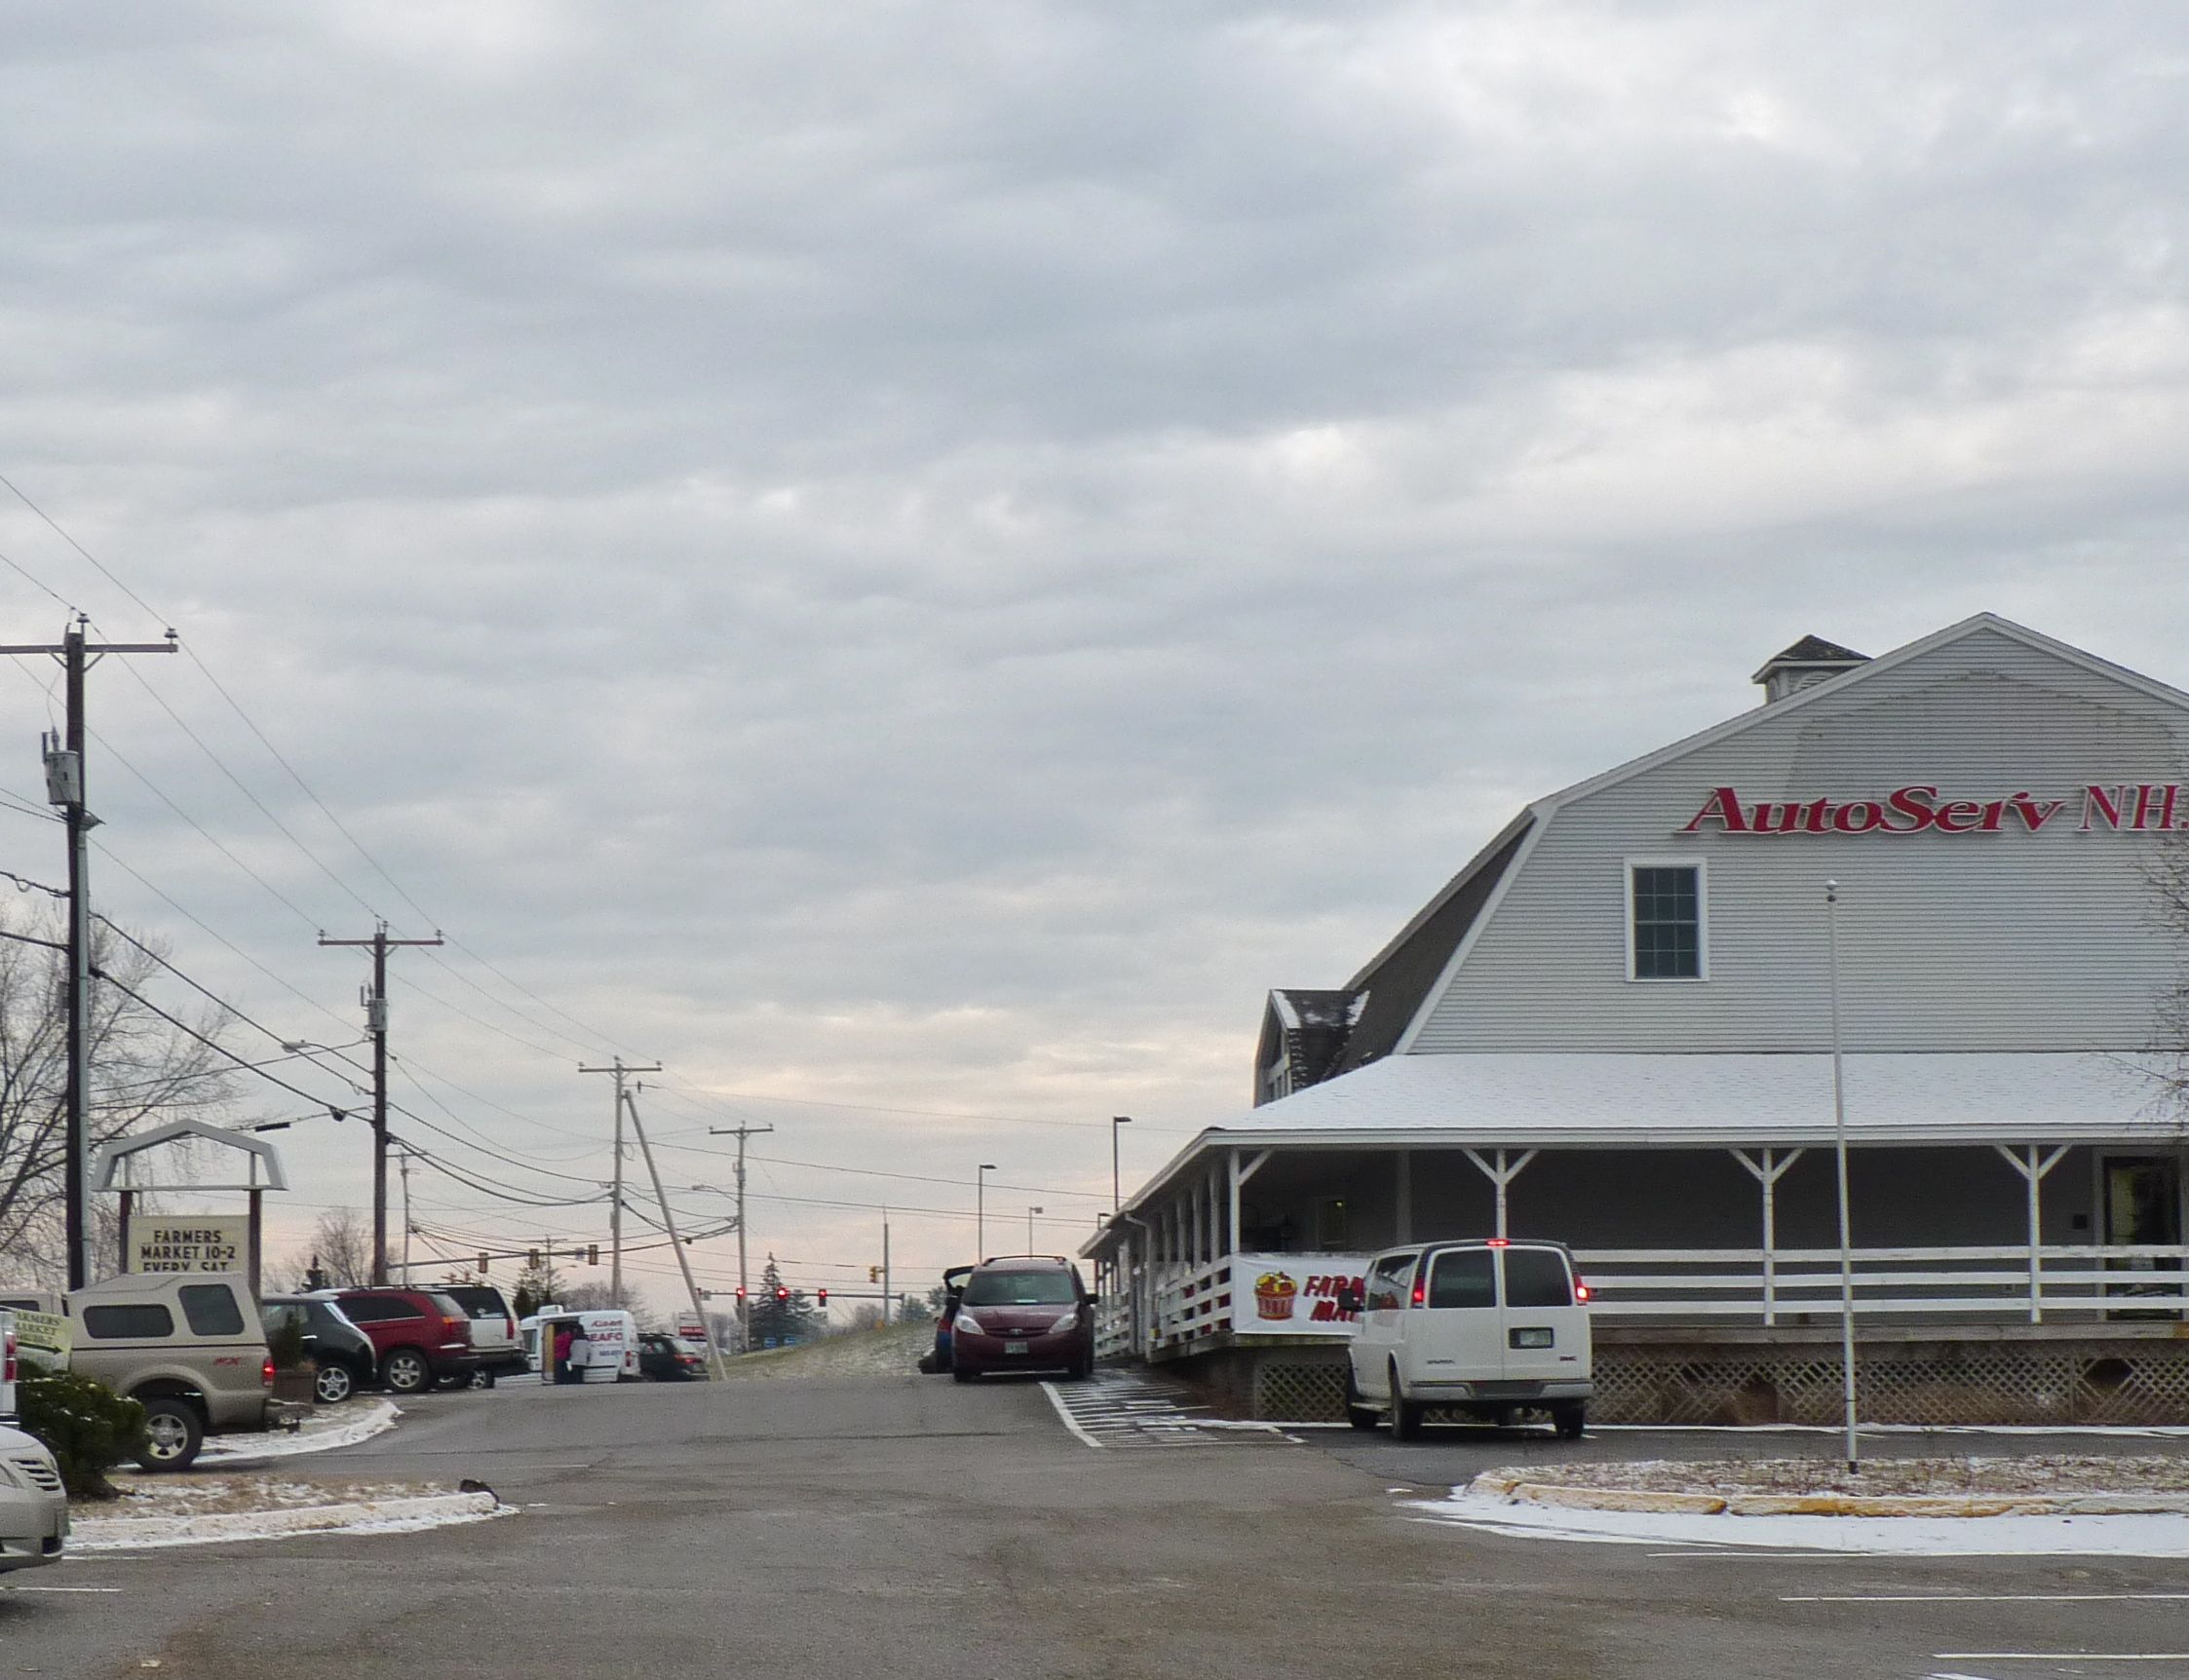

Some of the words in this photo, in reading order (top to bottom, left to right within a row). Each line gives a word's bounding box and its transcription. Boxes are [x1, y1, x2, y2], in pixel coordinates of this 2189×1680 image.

[1673, 785, 2069, 835] AutoServ
[154, 1230, 222, 1243] FARMERS
[140, 1246, 200, 1259] MARKET
[206, 1246, 236, 1259] 10-2
